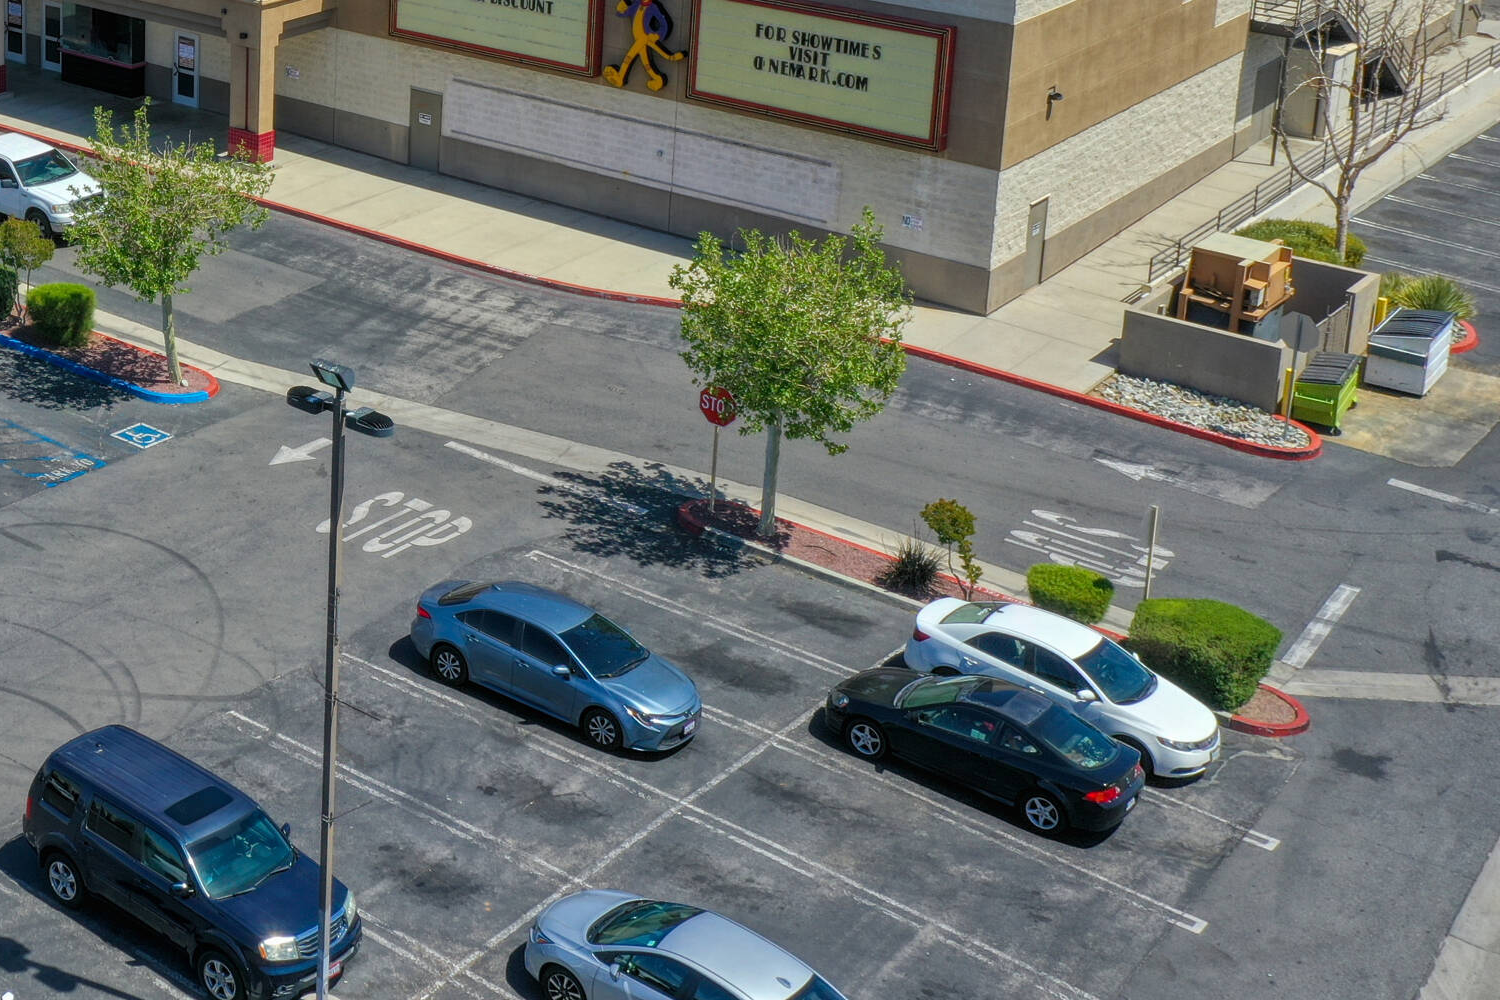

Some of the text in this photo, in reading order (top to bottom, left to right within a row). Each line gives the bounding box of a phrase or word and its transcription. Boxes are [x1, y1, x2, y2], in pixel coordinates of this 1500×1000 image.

[755, 23, 882, 60] FOR SHOWTIMES
[789, 46, 830, 67] VISIT
[315, 491, 473, 558] STOP
[1003, 508, 1176, 588] STOP
